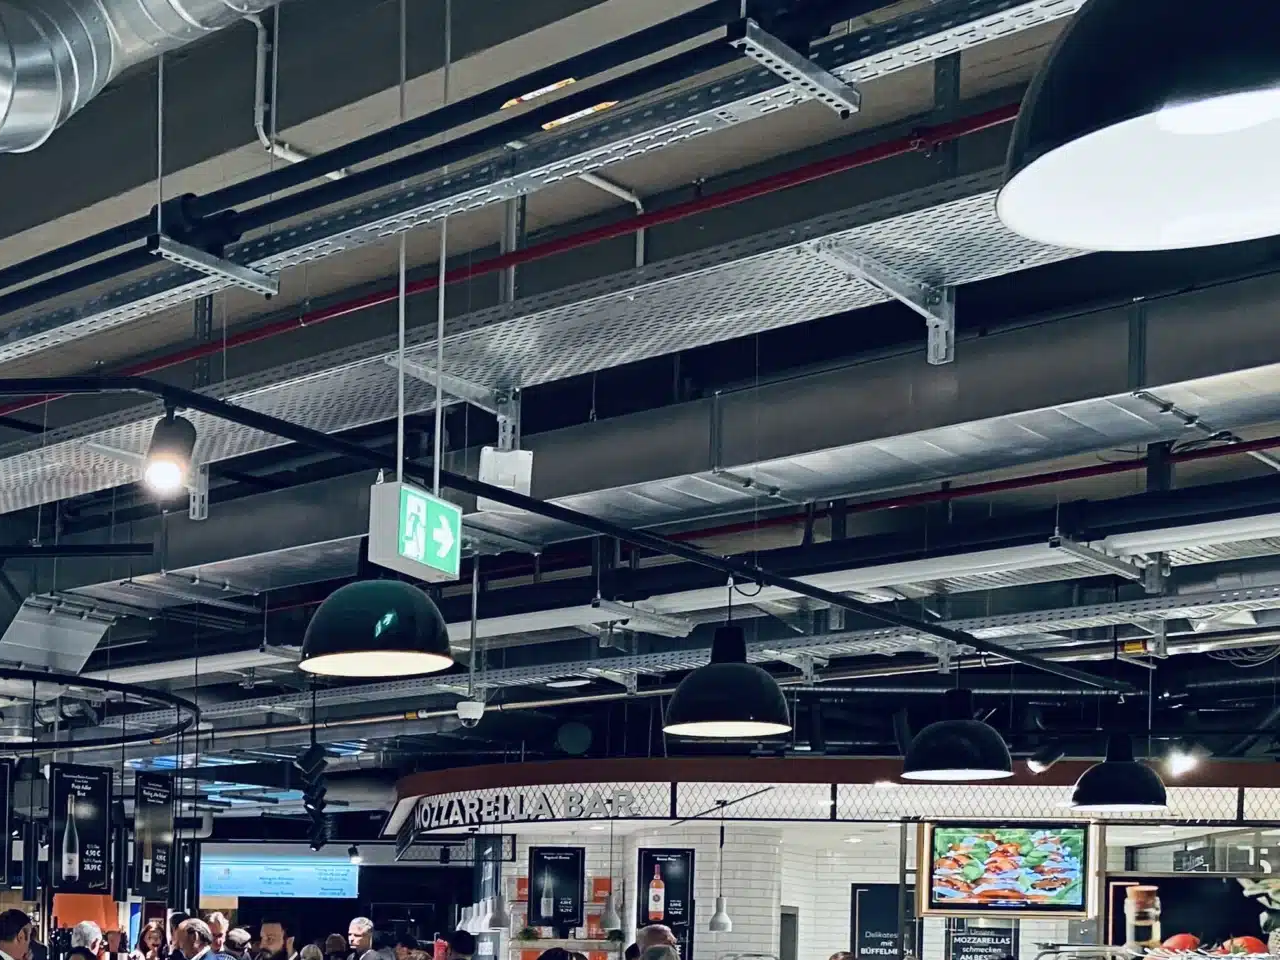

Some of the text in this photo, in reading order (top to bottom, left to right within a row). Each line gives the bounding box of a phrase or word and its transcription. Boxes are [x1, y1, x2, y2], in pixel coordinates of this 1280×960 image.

[415, 790, 638, 829] MOZZARELLA BAR
[953, 937, 1011, 945] MOZZARELLAS
[860, 947, 913, 955] BÜFFELMICH
